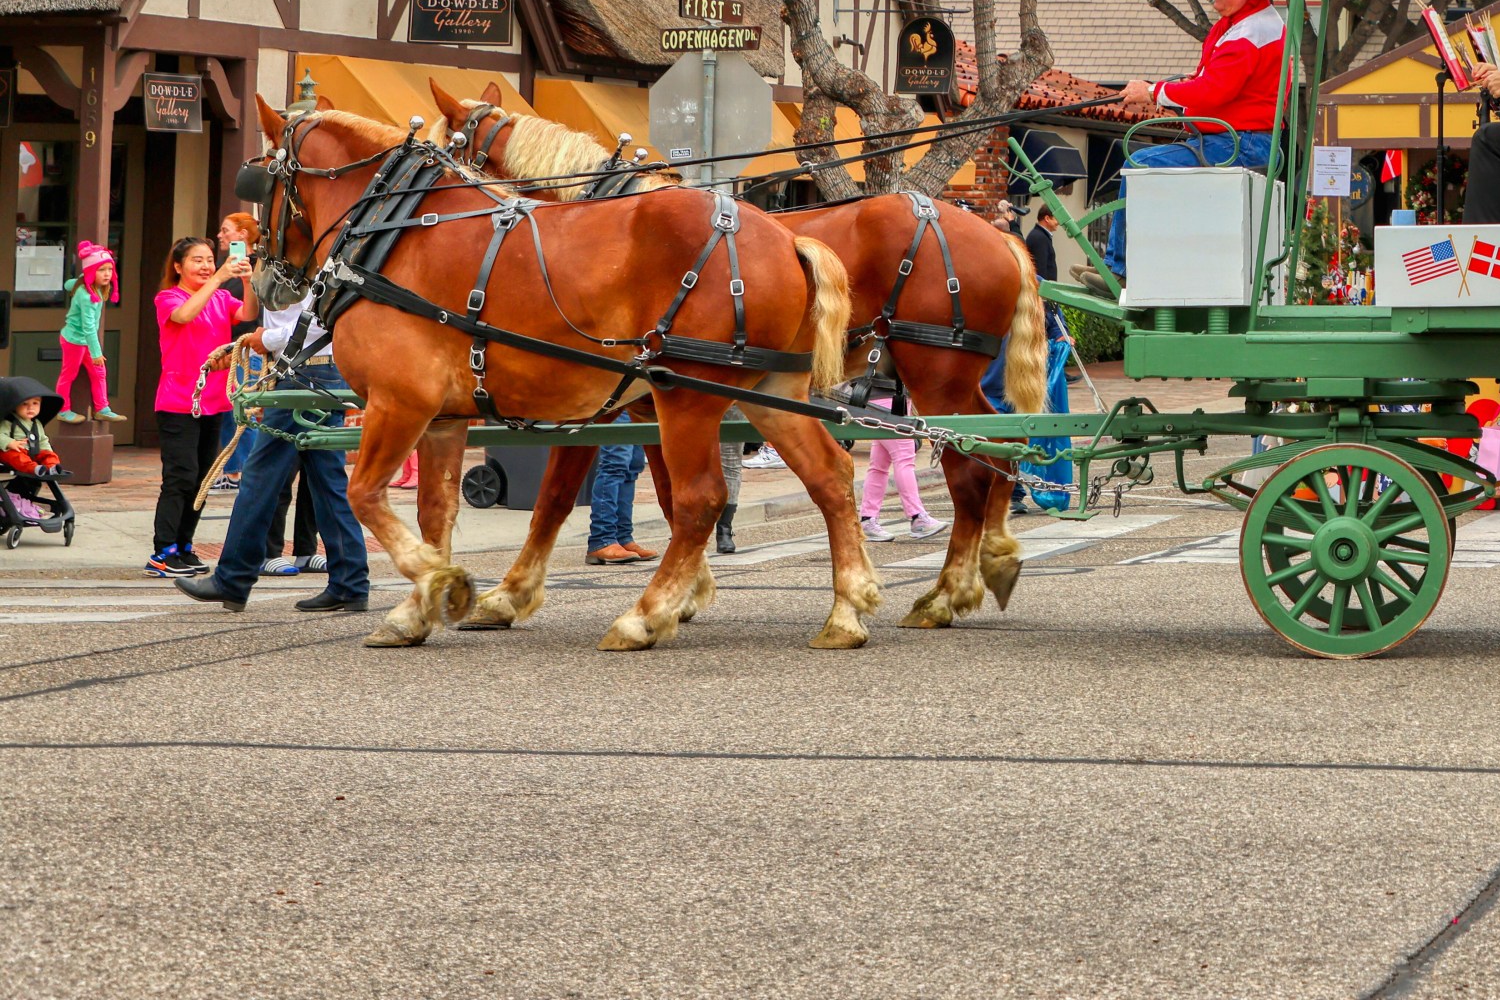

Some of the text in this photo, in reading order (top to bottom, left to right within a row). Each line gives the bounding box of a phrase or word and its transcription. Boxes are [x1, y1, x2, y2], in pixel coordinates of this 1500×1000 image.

[434, 8, 492, 34] Gallery
[662, 28, 744, 50] COPENHAGEN
[907, 74, 940, 89] Gallery
[155, 96, 189, 124] Gallery
